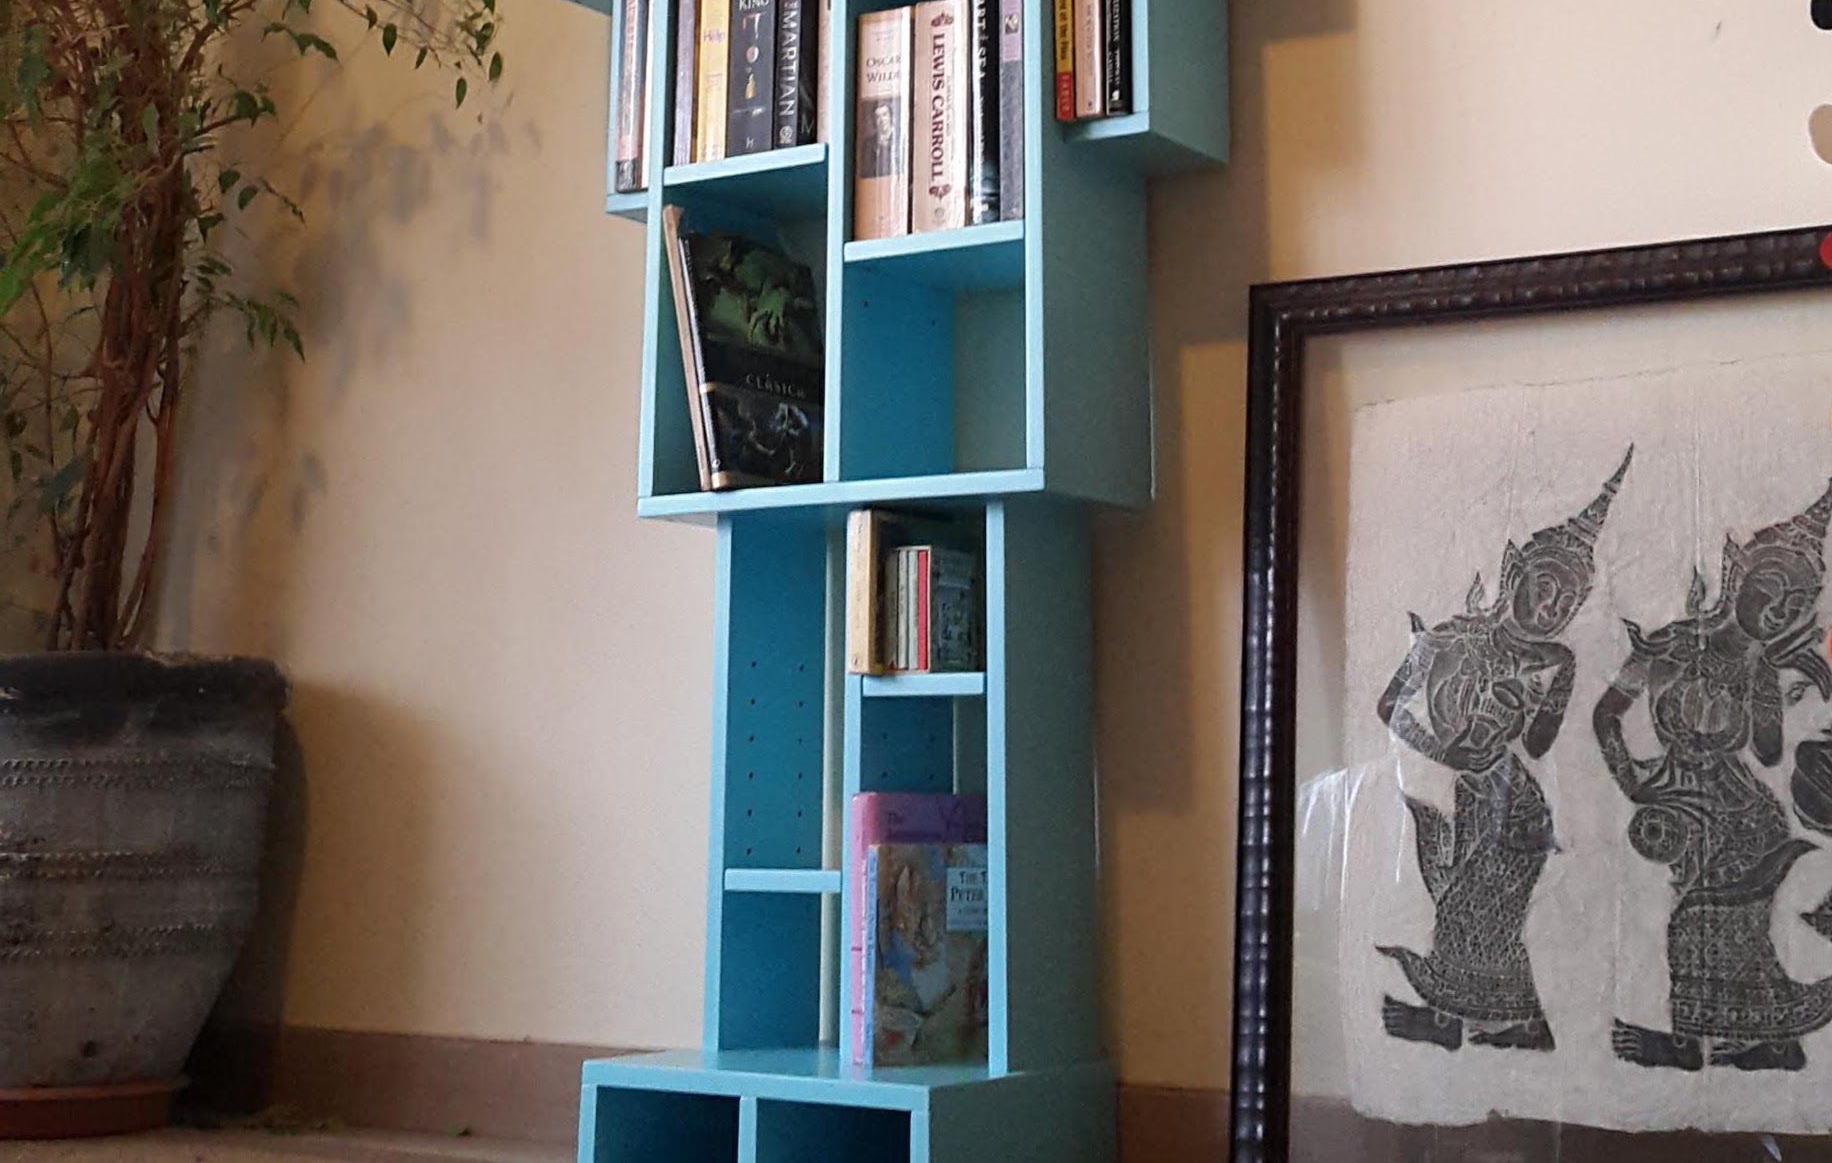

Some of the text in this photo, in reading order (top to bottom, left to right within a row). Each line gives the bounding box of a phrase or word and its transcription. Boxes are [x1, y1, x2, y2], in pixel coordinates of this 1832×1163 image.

[779, 9, 798, 116] MARTIAN
[931, 33, 945, 179] LEWIS CARROLL
